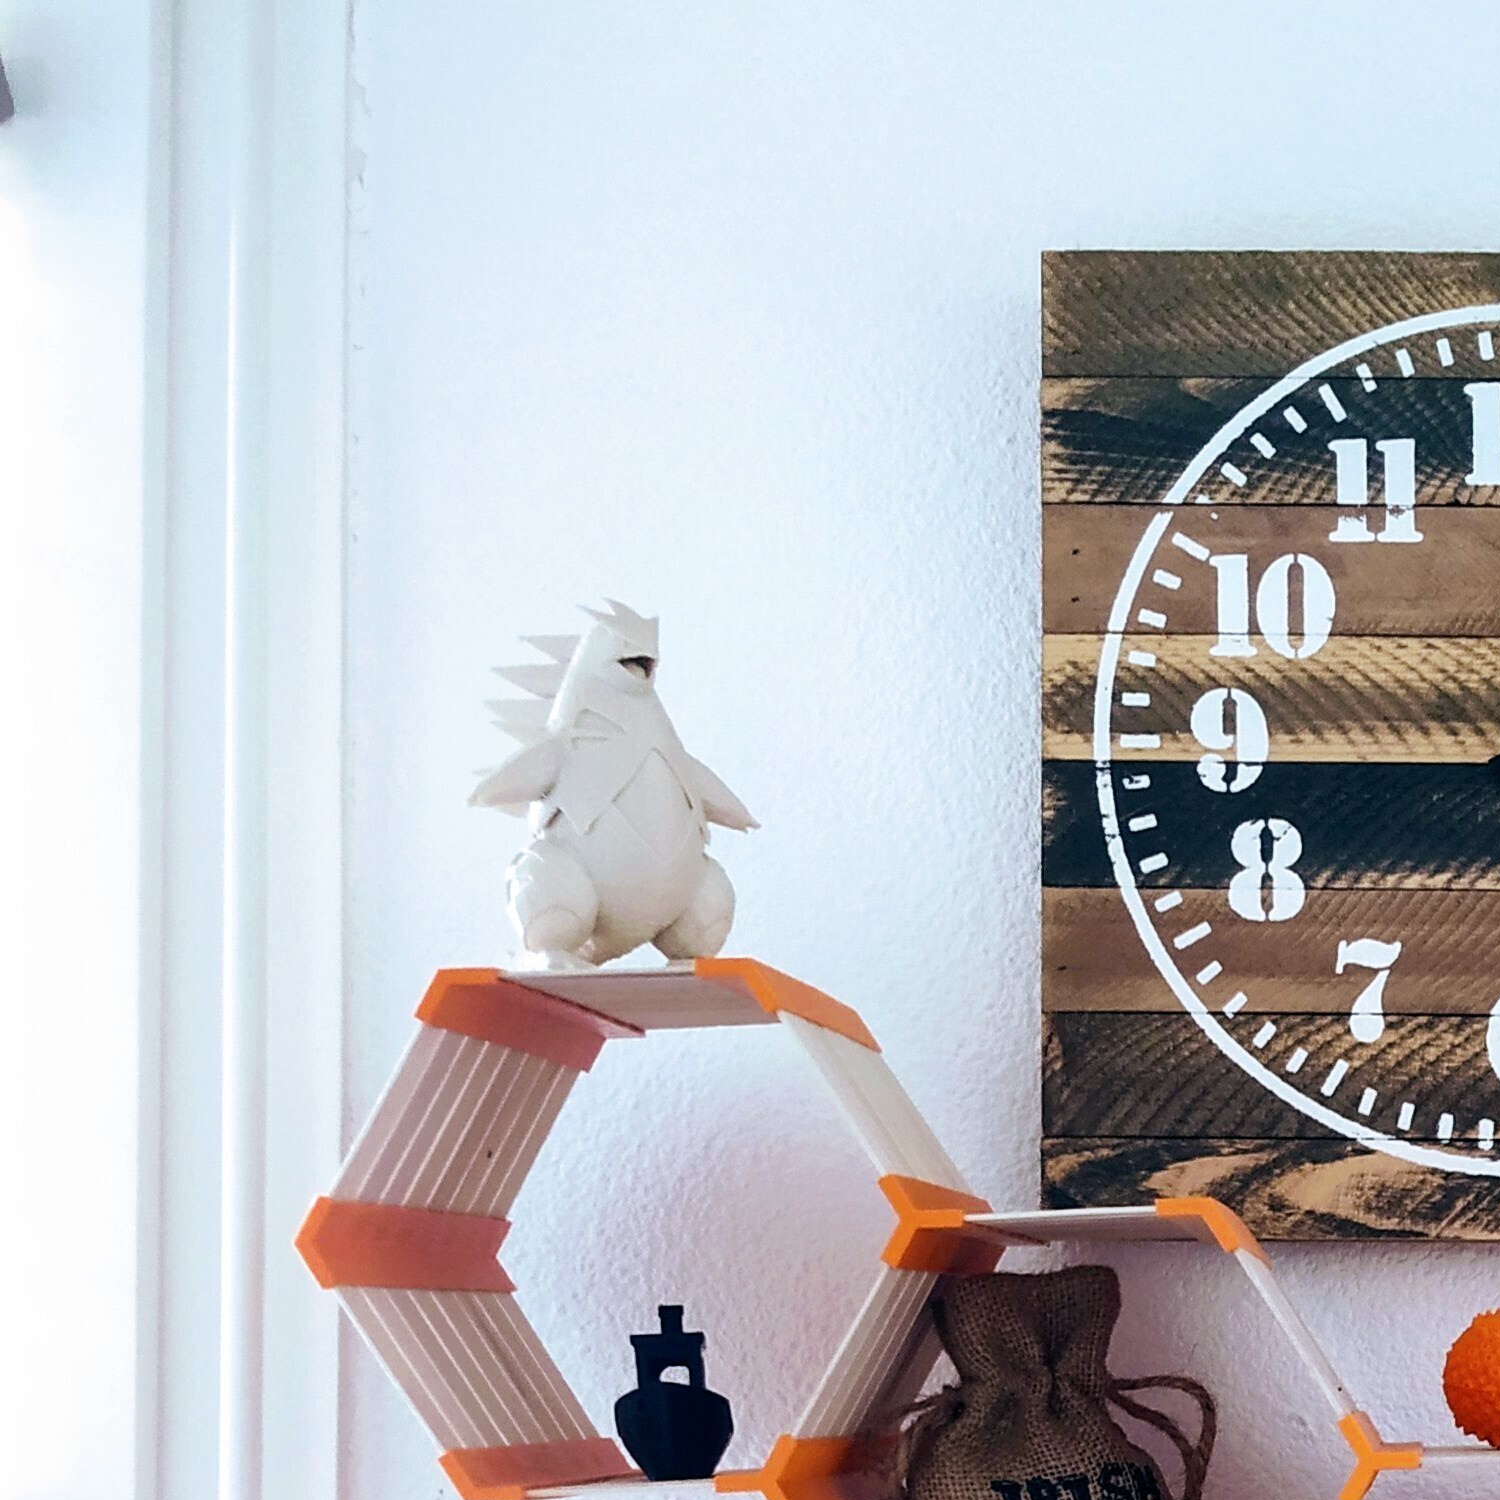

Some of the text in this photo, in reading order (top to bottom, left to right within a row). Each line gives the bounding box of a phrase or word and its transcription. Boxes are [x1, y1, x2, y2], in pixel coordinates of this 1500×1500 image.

[1328, 437, 1424, 543] 11
[1208, 552, 1336, 660] 10
[1190, 687, 1269, 793] 9
[1228, 818, 1306, 922] 8
[1334, 939, 1401, 1043] 7
